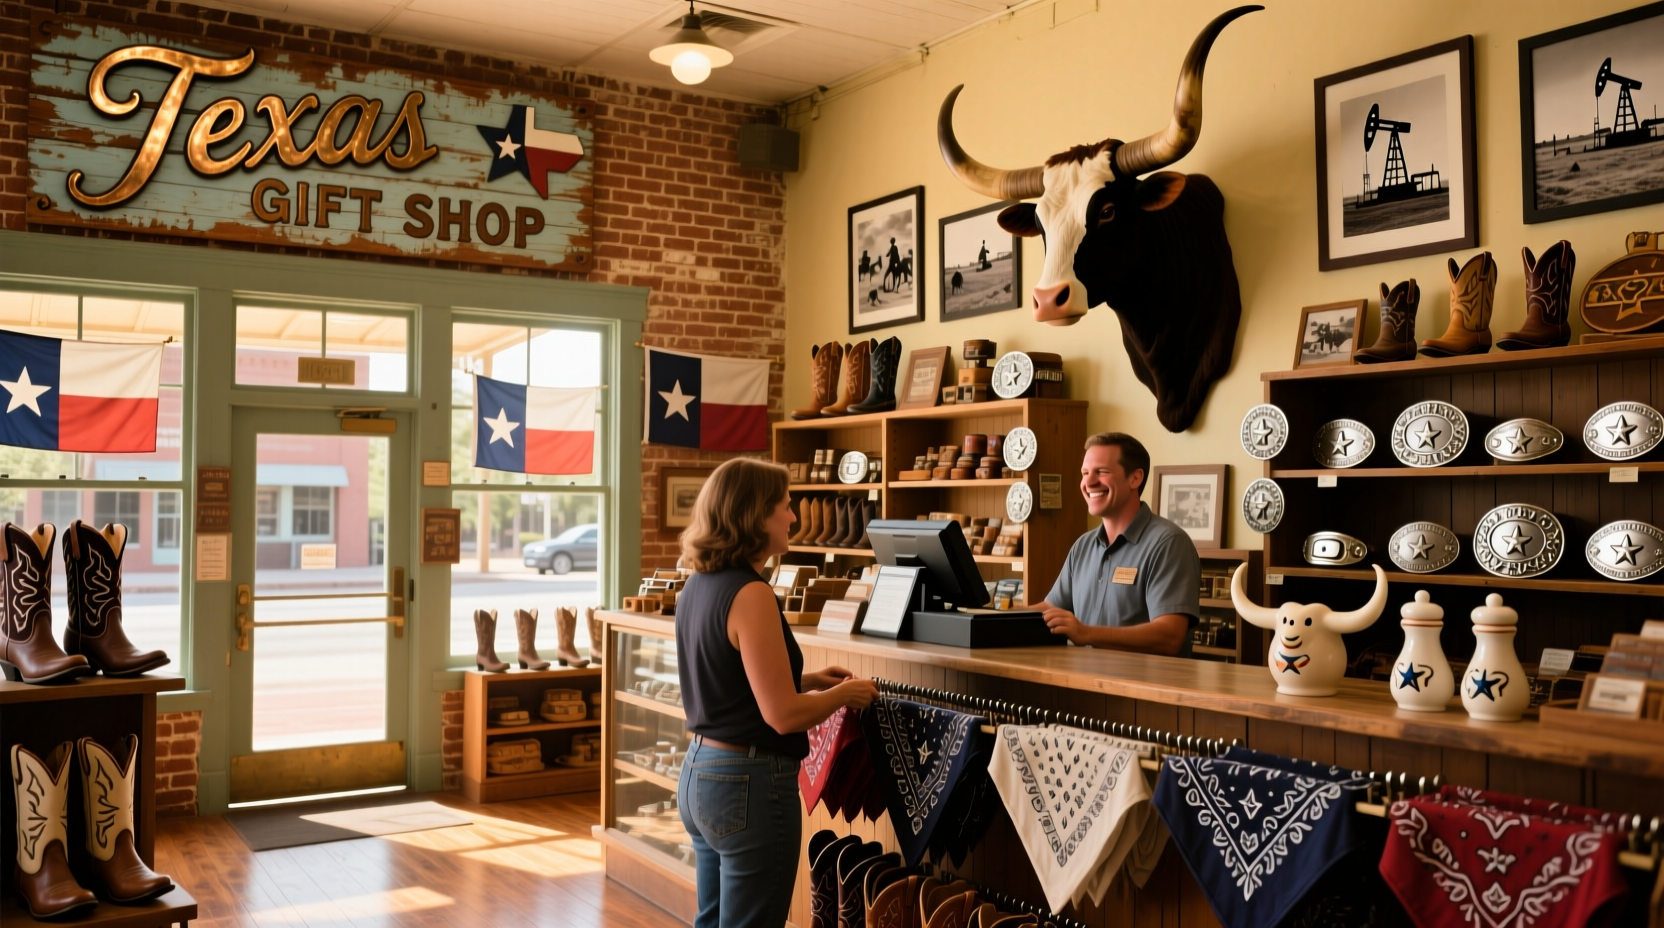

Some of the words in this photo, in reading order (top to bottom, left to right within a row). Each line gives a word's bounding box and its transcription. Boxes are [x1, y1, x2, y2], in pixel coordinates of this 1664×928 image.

[67, 45, 438, 208] Texas
[251, 178, 383, 233] GIFT
[403, 193, 545, 248] SHOP
